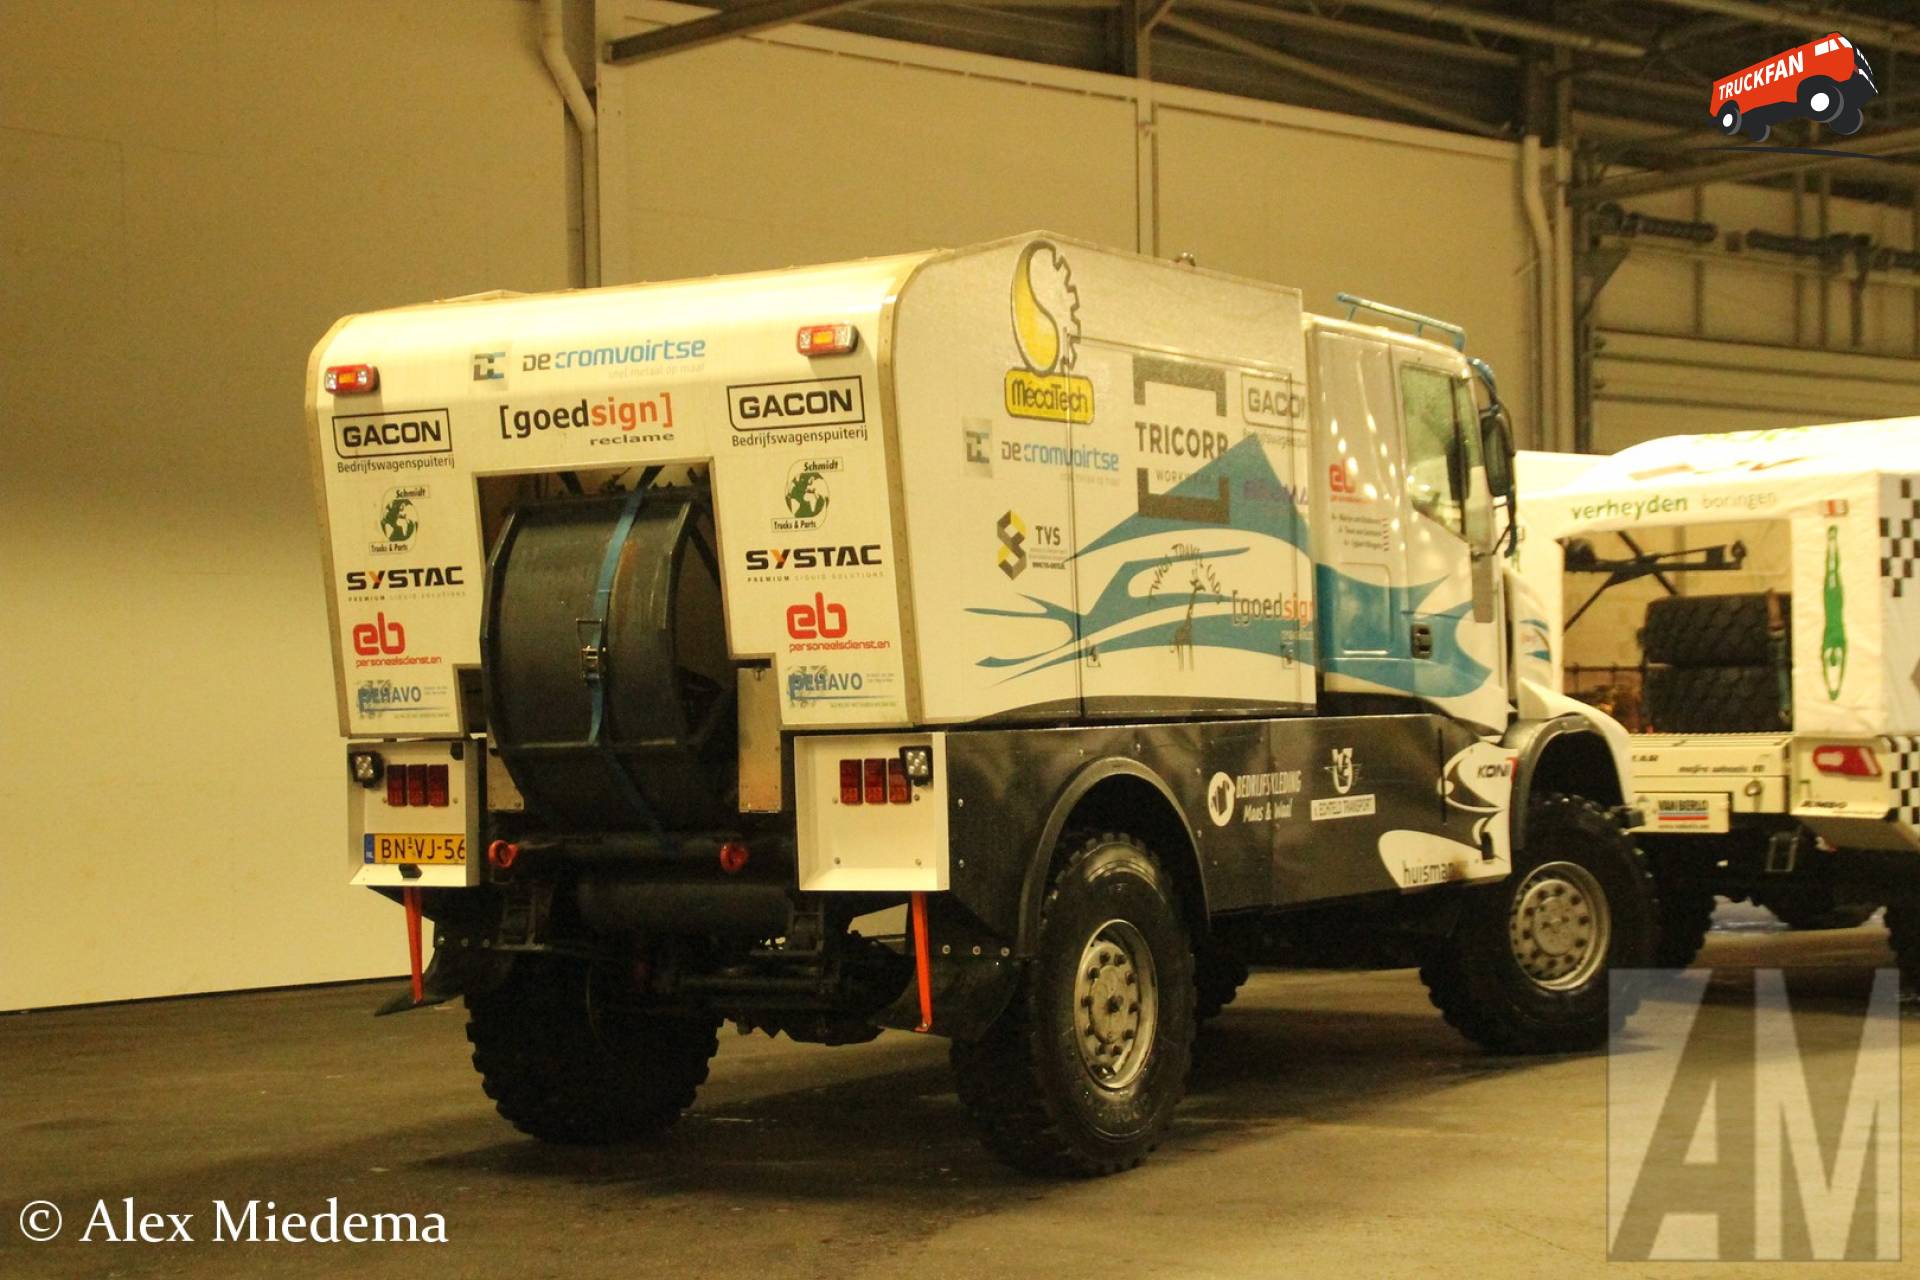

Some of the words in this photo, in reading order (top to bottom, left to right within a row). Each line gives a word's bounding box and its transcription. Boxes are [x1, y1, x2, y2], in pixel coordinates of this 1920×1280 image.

[554, 339, 706, 369] cromvoirtse
[739, 388, 853, 419] GACON
[1012, 377, 1088, 413] MécaTech
[499, 392, 673, 439] [goedsign]
[342, 420, 442, 448] GACON
[590, 432, 675, 446] reclame
[732, 426, 868, 447] Bedrijfswagenspuiterij
[1134, 421, 1229, 462] TRICORP
[337, 455, 455, 475] Bedrijfswagenspuiterij
[803, 459, 838, 472] Schmidt
[1024, 443, 1120, 471] cromvoirtse
[395, 487, 426, 499] Schmidt
[1571, 495, 1688, 520] verheyden
[1702, 491, 1776, 511] boringen
[774, 520, 793, 530] Trucks
[794, 520, 799, 529] &
[800, 519, 816, 529] Parts
[1035, 525, 1061, 546] TVS
[745, 544, 882, 571] SYSTAC
[346, 566, 464, 591] SYSTAC
[747, 575, 790, 583] PREMIUM
[786, 591, 848, 639] eb
[352, 612, 405, 656] eb
